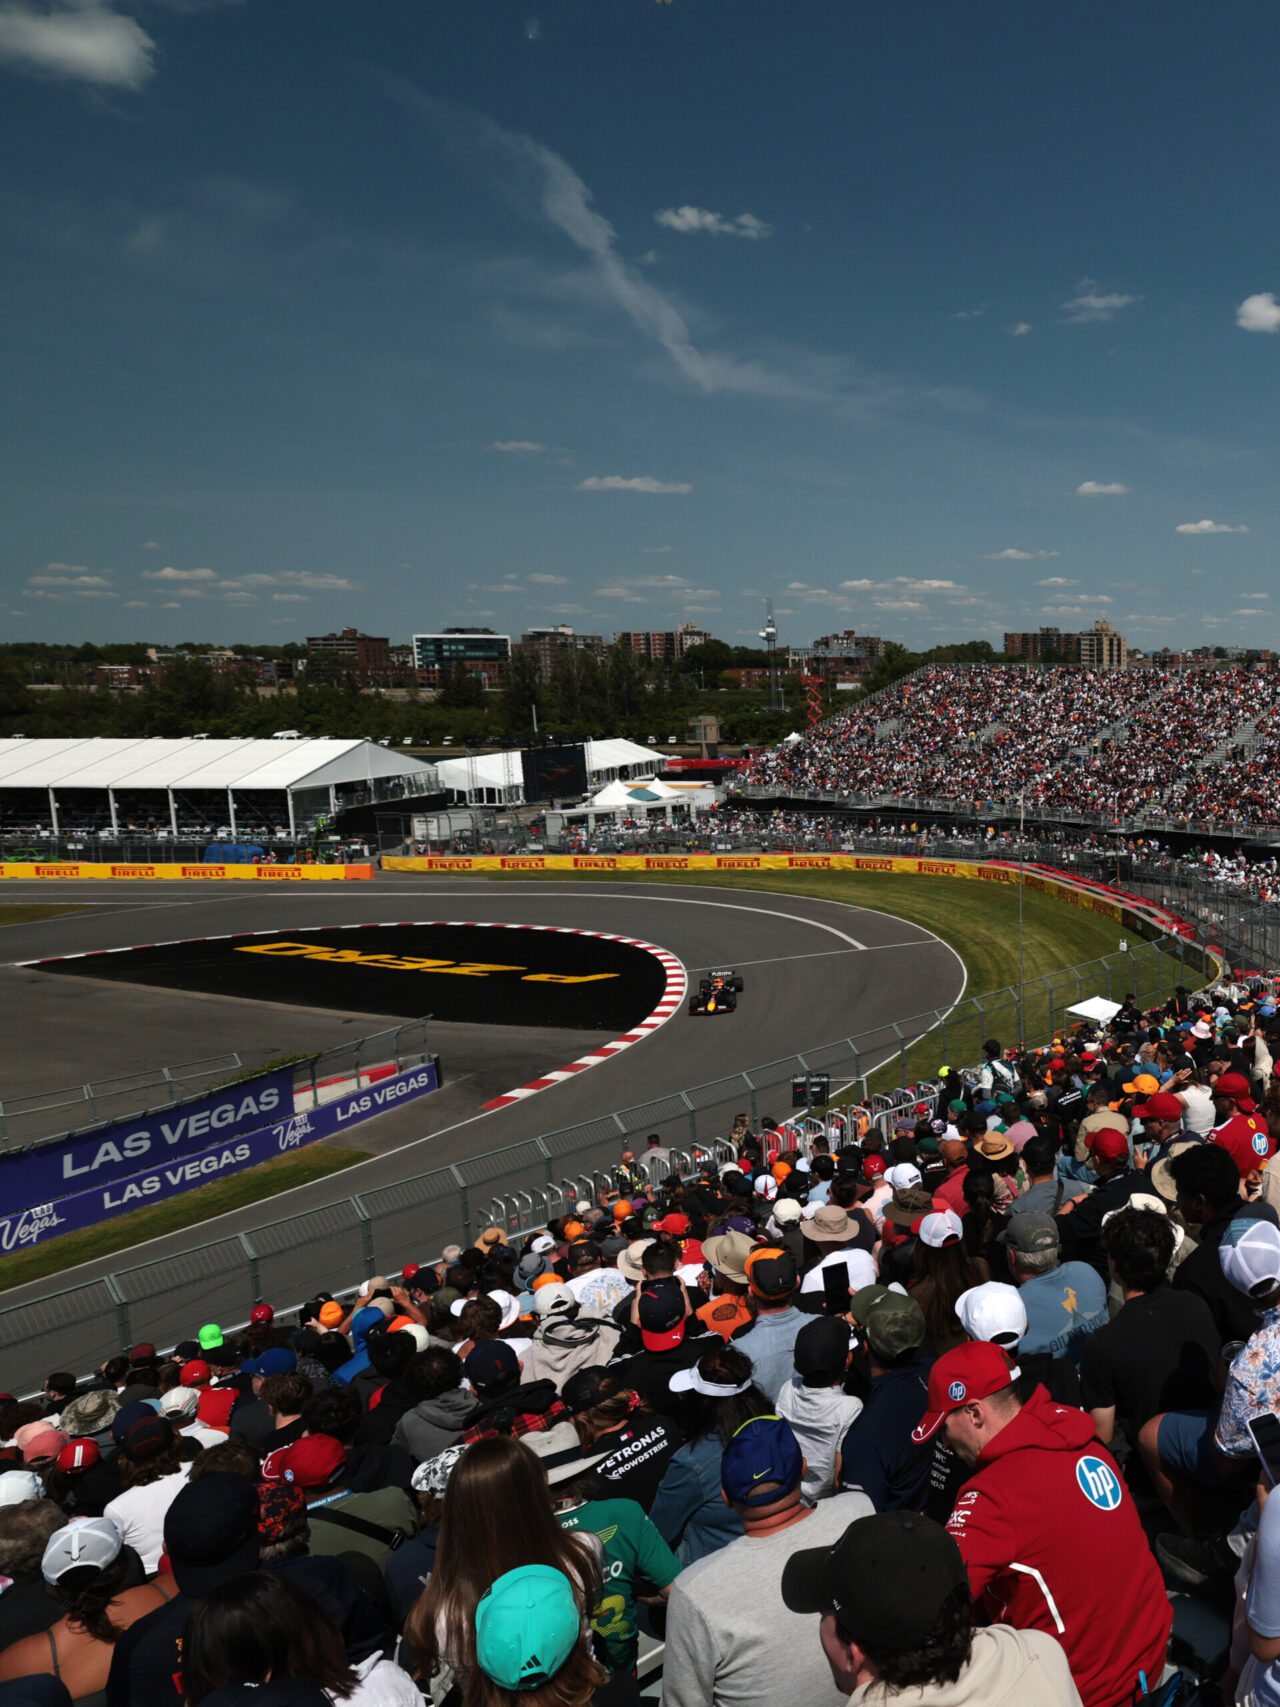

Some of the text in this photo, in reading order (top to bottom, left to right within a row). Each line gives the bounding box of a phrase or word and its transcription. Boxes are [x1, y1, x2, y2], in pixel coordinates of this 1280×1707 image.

[428, 858, 473, 869] PIRELLI
[501, 857, 545, 869] PIRELLI
[573, 857, 617, 869] PIRELLI
[645, 857, 689, 869] PIRELLI
[717, 857, 761, 869] PIRELLI
[789, 857, 831, 868] PIRELLI
[855, 858, 893, 871] PIRELLI
[918, 861, 956, 874] PIRELLI
[35, 866, 79, 876] PIRELLI
[111, 866, 155, 877] PIRELLI
[181, 866, 226, 877] PIRELLI
[256, 867, 302, 877] PIRELLI
[978, 867, 1009, 881] PIRELLI
[233, 942, 529, 976] ZERO
[337, 1072, 429, 1121] LAS VEGAS
[62, 1087, 280, 1179] LAS VEGAS
[272, 1120, 315, 1150] Vegas
[1252, 1133, 1268, 1155] hp
[103, 1144, 251, 1210] LAS VEGAS
[33, 1204, 53, 1218] LAS
[0, 1210, 66, 1250] Vegas
[611, 1438, 670, 1478] CROWDSTRIKE
[933, 1449, 947, 1464] WC
[1080, 1458, 1116, 1508] hp
[560, 1517, 580, 1529] OSS
